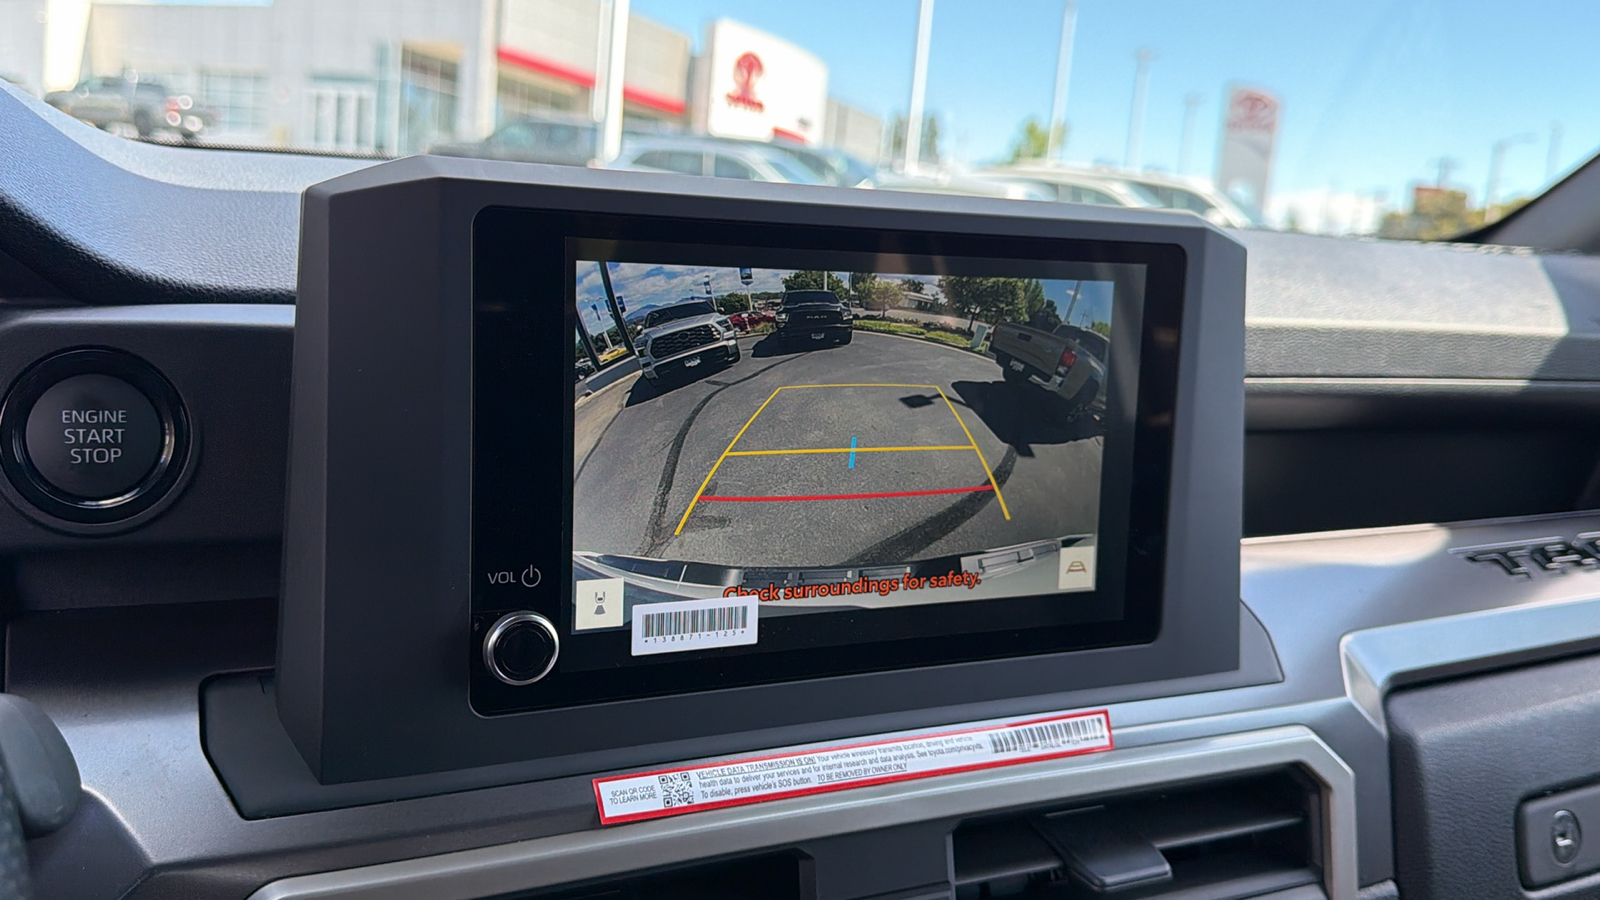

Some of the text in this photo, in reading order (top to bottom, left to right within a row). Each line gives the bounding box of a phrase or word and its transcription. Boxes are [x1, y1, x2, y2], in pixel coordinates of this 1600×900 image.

[62, 410, 127, 423] ENGINE
[64, 428, 125, 444] START
[70, 448, 122, 463] STOP
[487, 571, 516, 584] VOL
[784, 577, 899, 598] surroundings
[903, 572, 926, 590] for
[929, 570, 981, 589] safety.
[696, 768, 726, 779] VEHICLE
[727, 766, 745, 776] DATA
[746, 758, 796, 773] TRANSMISSION
[796, 758, 802, 766] IS
[803, 756, 816, 765] ON!
[817, 754, 830, 762] Your
[831, 752, 850, 760] vehicle
[851, 748, 878, 758] wirelessly
[878, 745, 901, 754] transmits
[902, 742, 926, 751] location,
[944, 738, 954, 746] and
[700, 780, 718, 789] health
[719, 778, 733, 786] data
[734, 776, 740, 784] to
[741, 774, 761, 783] deliver
[762, 773, 775, 782] your
[776, 770, 800, 778] services
[801, 767, 812, 775] and
[814, 764, 822, 774] for
[822, 761, 842, 772] internal
[843, 757, 868, 768] research
[868, 756, 879, 765] and
[880, 754, 892, 763] data
[893, 752, 916, 762] analysis.
[916, 750, 928, 758] See
[701, 762, 907, 799] To disable, press vehicle's SOS button. TO BE REMOVED BY OWNER ONLY
[610, 792, 657, 805] TO LEARN MORE
[611, 789, 628, 797] SCAN
[639, 785, 656, 794] CODE
